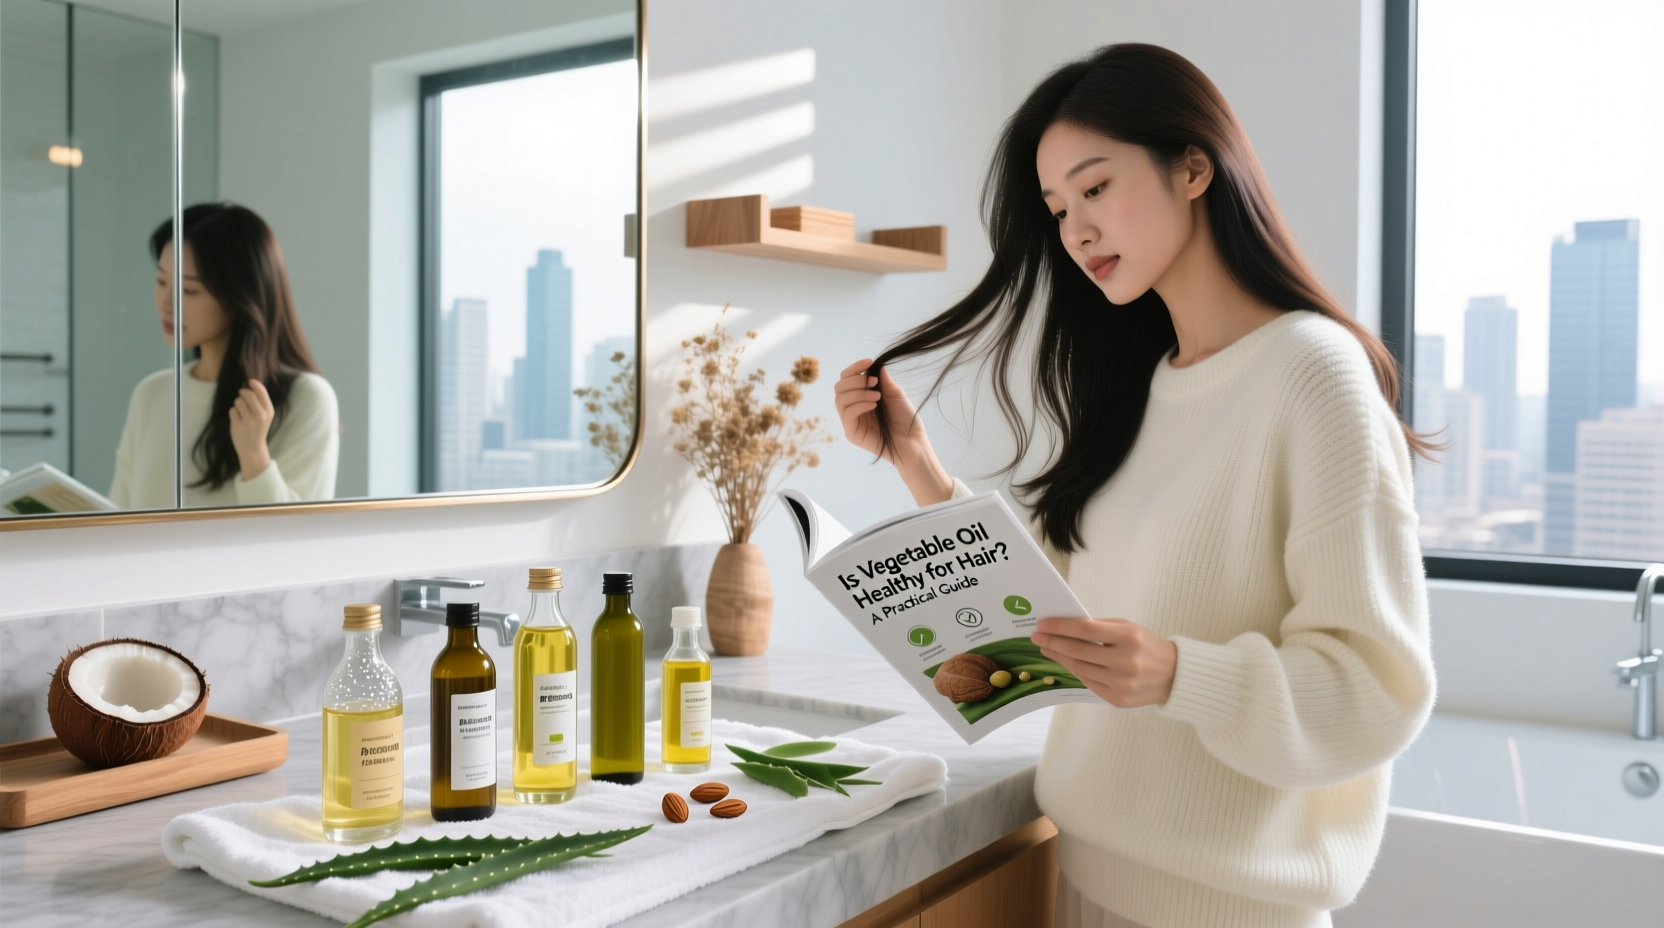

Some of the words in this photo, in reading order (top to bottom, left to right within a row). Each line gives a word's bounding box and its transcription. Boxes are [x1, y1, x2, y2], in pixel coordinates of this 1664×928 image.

[837, 574, 860, 591] Is
[856, 535, 956, 579] Vegetable
[956, 521, 989, 545] Oil
[852, 572, 925, 609] Healthy
[925, 560, 955, 580] for
[956, 541, 1009, 570] Hair?
[871, 612, 883, 625] A
[881, 586, 938, 619] Practical
[939, 575, 979, 595] Guide
